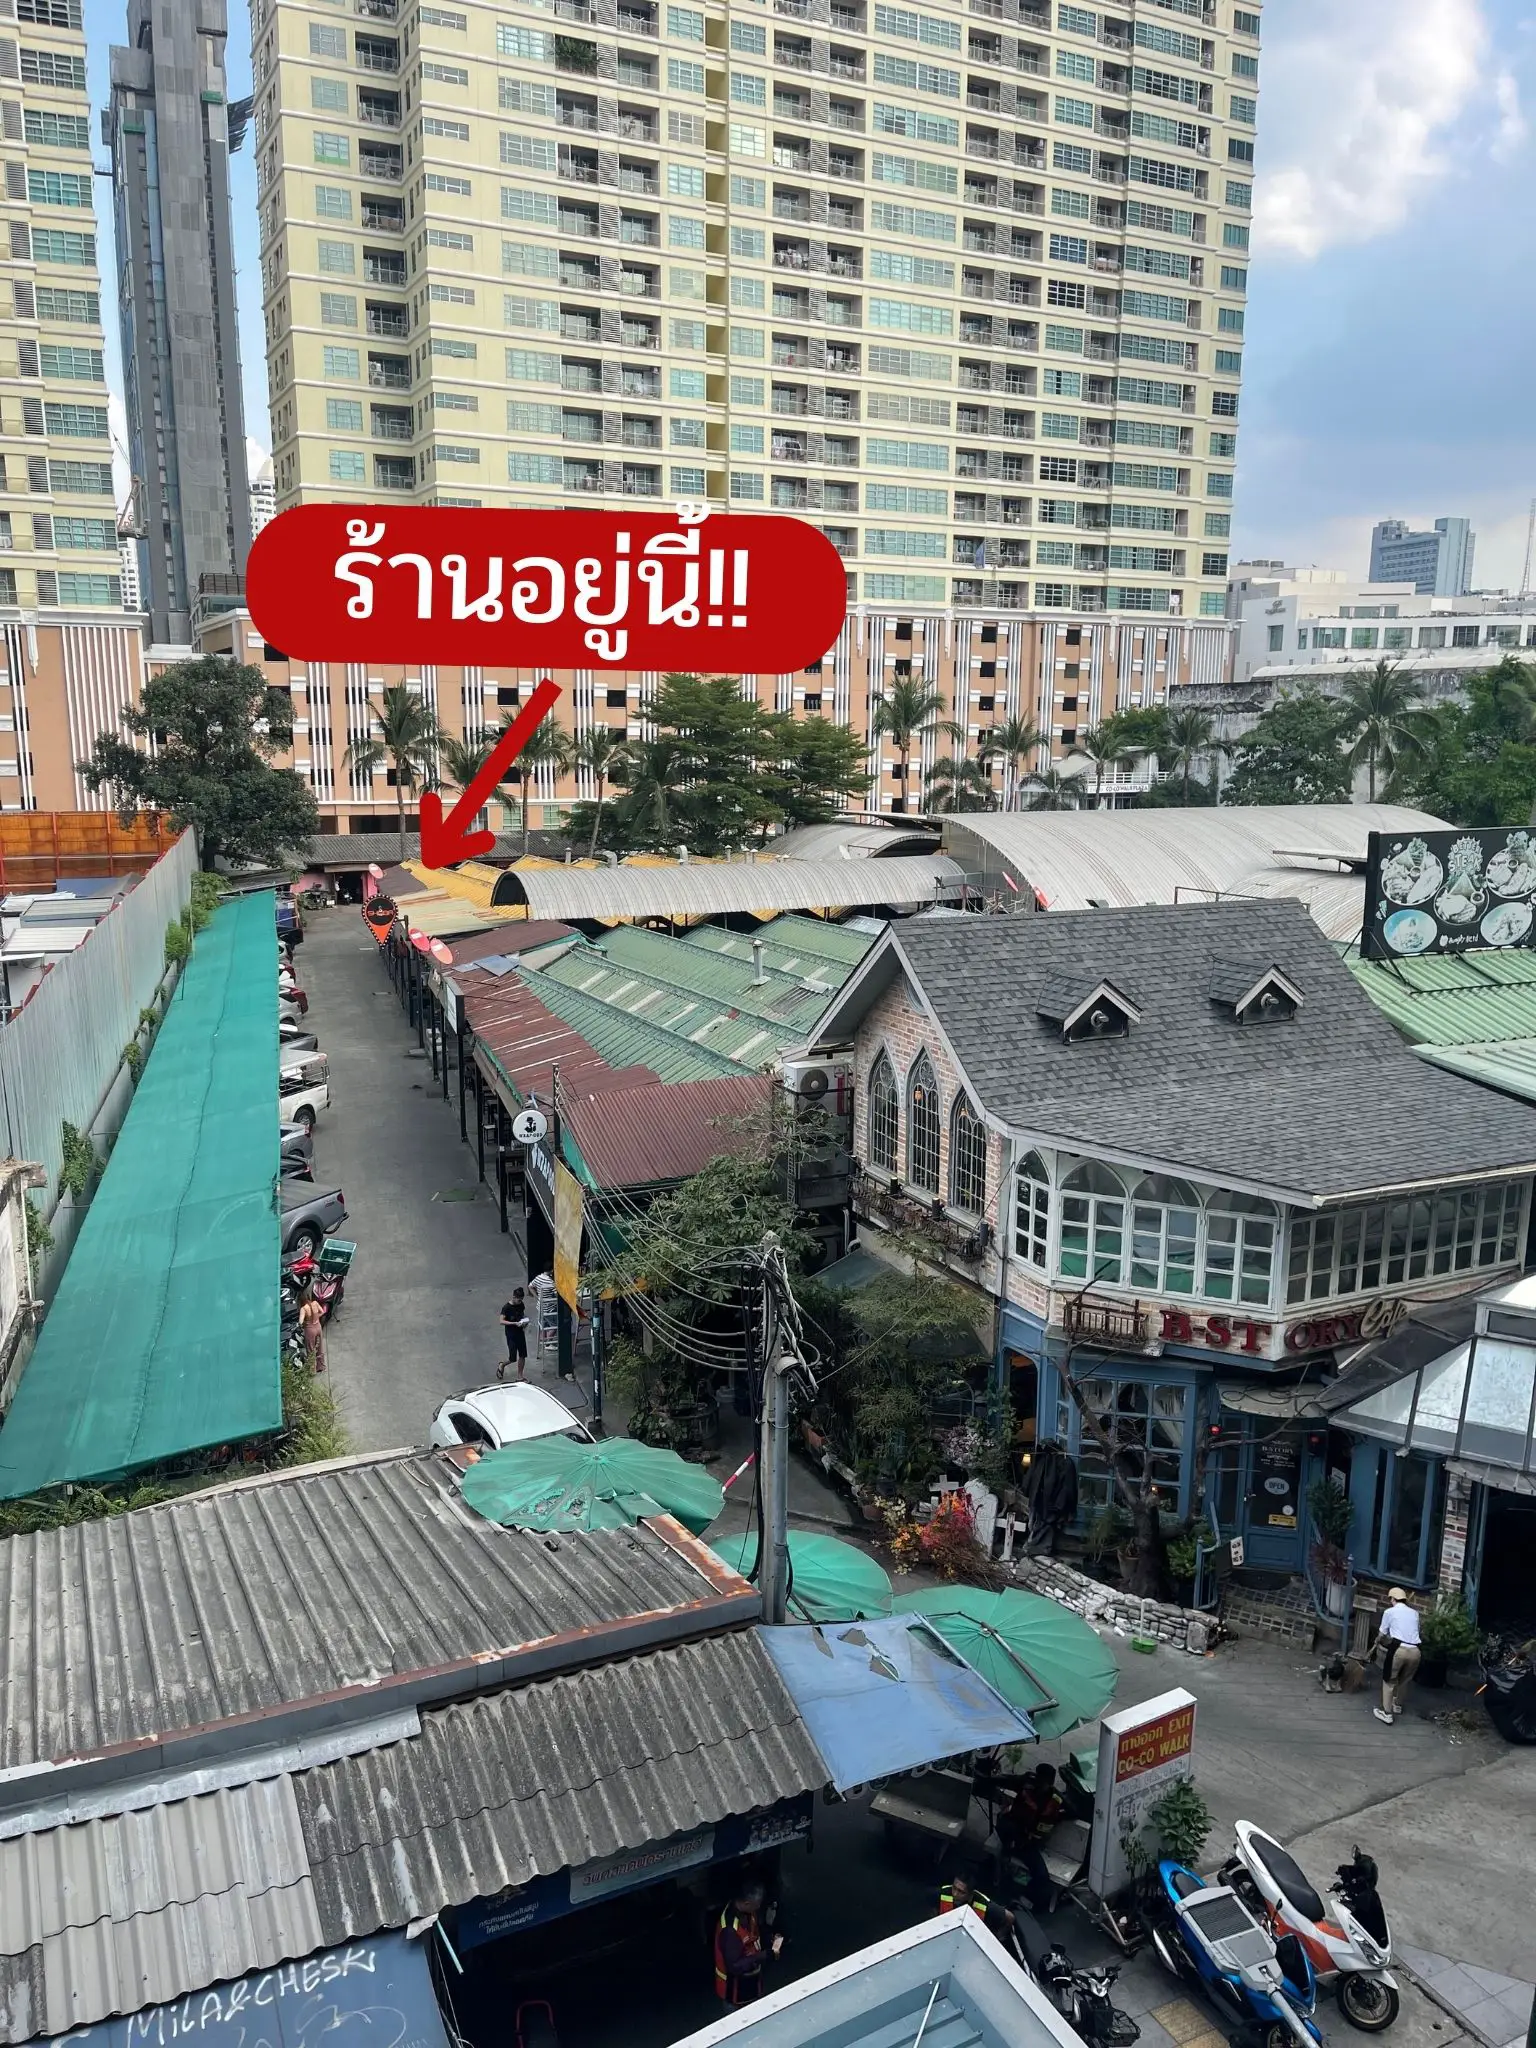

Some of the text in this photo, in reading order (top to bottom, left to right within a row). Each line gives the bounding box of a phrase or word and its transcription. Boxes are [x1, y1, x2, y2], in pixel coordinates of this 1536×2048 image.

[1447, 852, 1482, 872] STEAK
[1268, 1481, 1285, 1490] OPEN
[1121, 1711, 1193, 1754] ทางออก EXIT
[1117, 1733, 1190, 1774] CO-CO WALK
